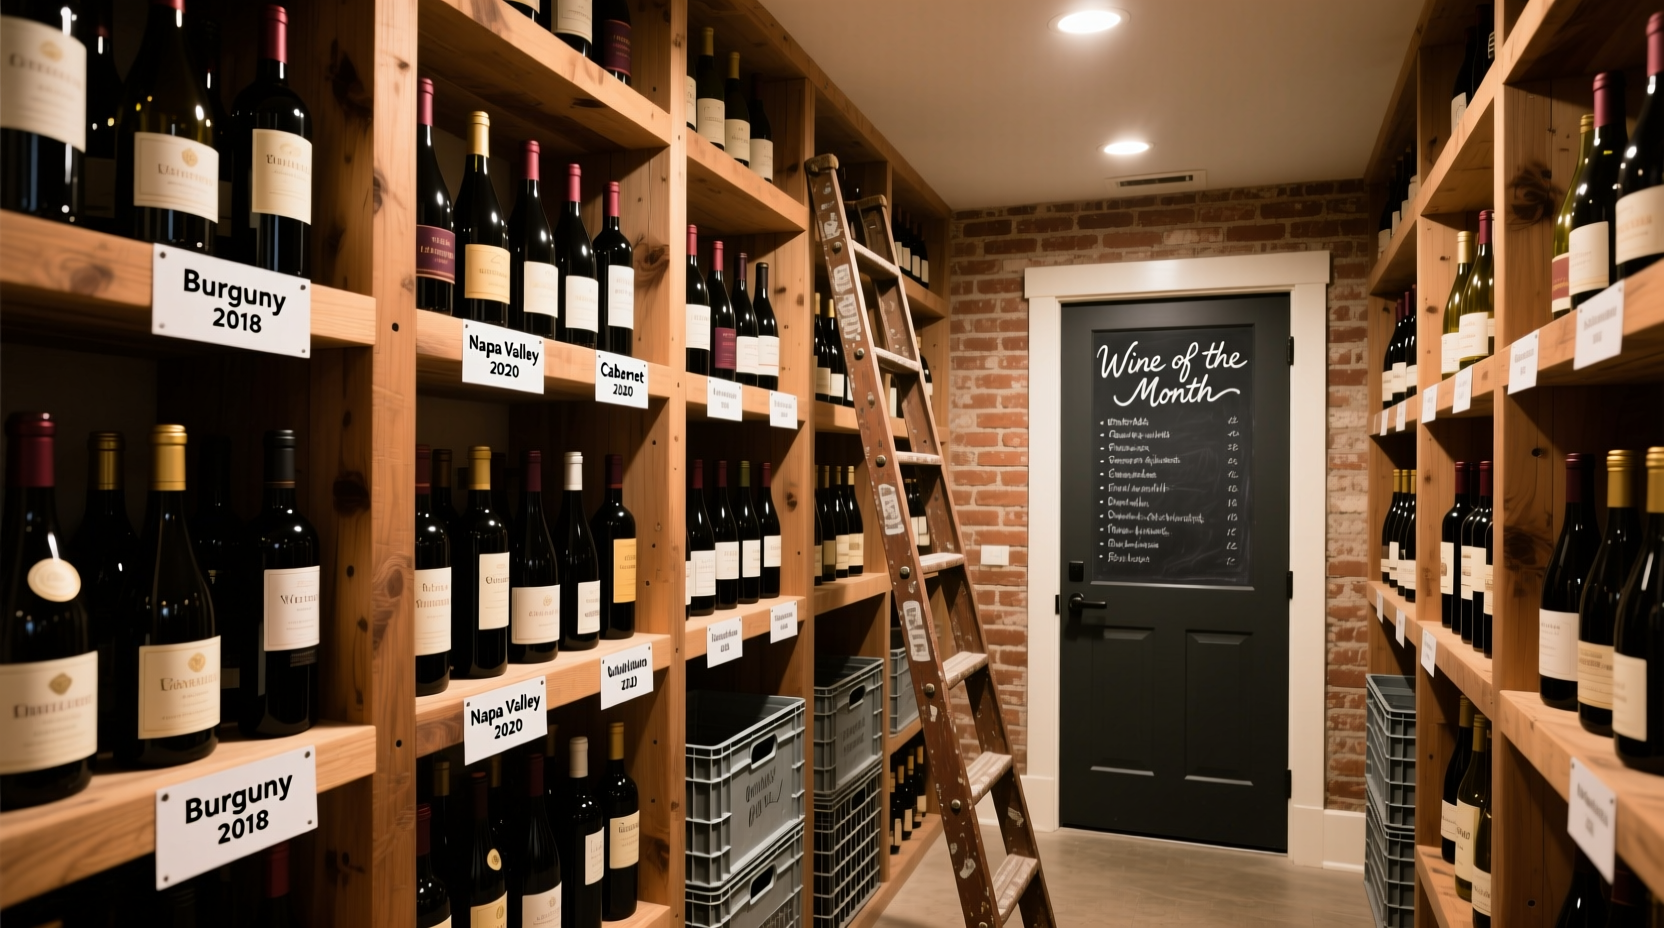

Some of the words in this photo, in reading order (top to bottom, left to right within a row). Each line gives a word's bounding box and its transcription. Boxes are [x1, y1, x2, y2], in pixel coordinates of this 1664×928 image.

[184, 269, 286, 316] Burguny
[213, 308, 262, 333] 2018
[469, 334, 502, 358] Napa
[504, 340, 540, 367] Valley
[1097, 341, 1166, 379] Wine
[1172, 342, 1199, 383] of
[1202, 341, 1247, 369] the
[489, 361, 520, 378] 2020
[1113, 374, 1240, 407] Month
[471, 707, 503, 726] Napa
[505, 694, 541, 711] Valley
[495, 719, 522, 739] 2020
[185, 775, 293, 825] Burguny
[217, 810, 269, 845] 2018
